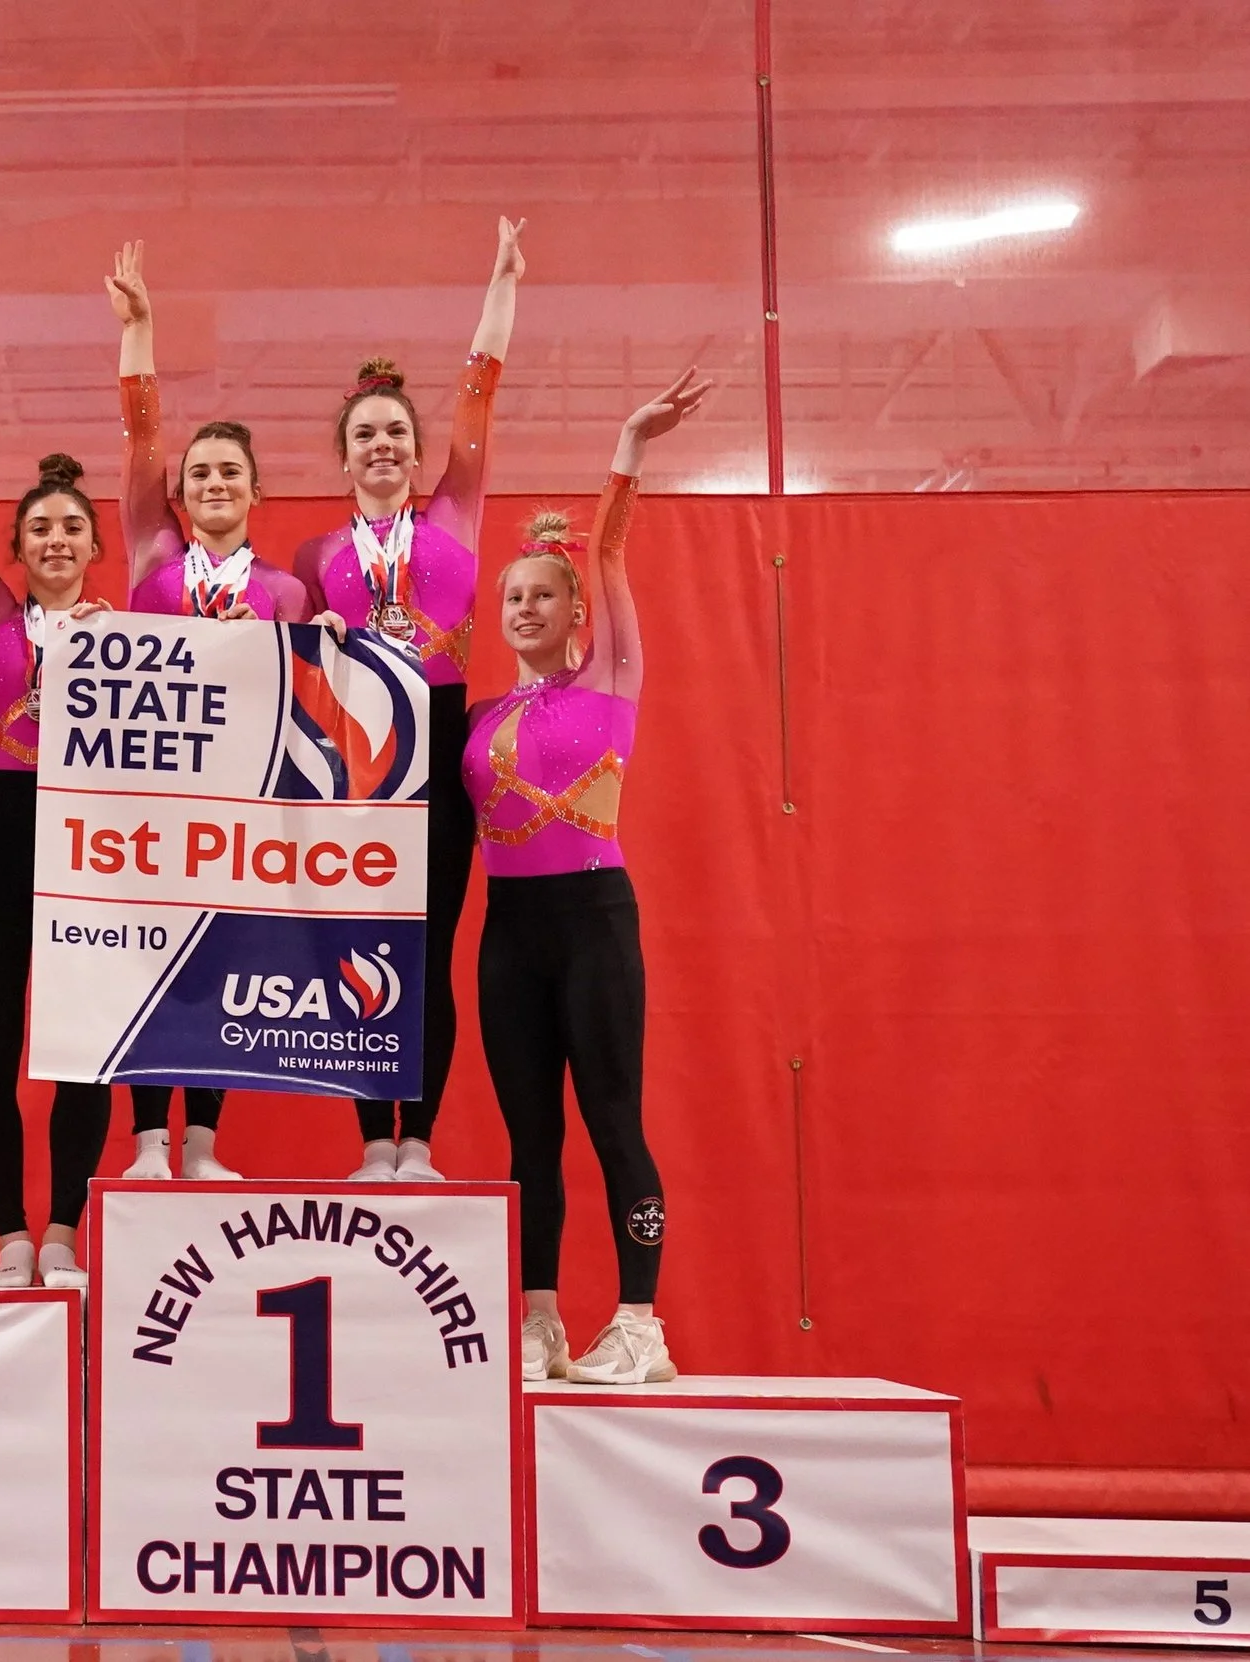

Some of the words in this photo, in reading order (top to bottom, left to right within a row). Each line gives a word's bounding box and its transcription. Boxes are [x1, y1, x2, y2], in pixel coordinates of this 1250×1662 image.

[67, 630, 195, 674] 2024
[66, 677, 227, 726] STATE
[63, 726, 214, 773] MEET
[64, 817, 162, 876] 1st
[184, 821, 399, 888] Place
[51, 919, 128, 950] Level
[137, 925, 167, 951] 10
[221, 973, 331, 1021] USA
[220, 1021, 400, 1053] Gymnastics
[278, 1056, 312, 1069] NEW
[313, 1058, 399, 1073] HAMPSHIRE
[132, 1243, 215, 1366] NEW
[219, 1199, 489, 1370] HAMPSHIRE
[256, 1276, 364, 1451] 1
[215, 1466, 406, 1522] STATE
[698, 1455, 791, 1569] 3
[136, 1540, 486, 1600] CHAMPION
[1193, 1579, 1232, 1626] 5
